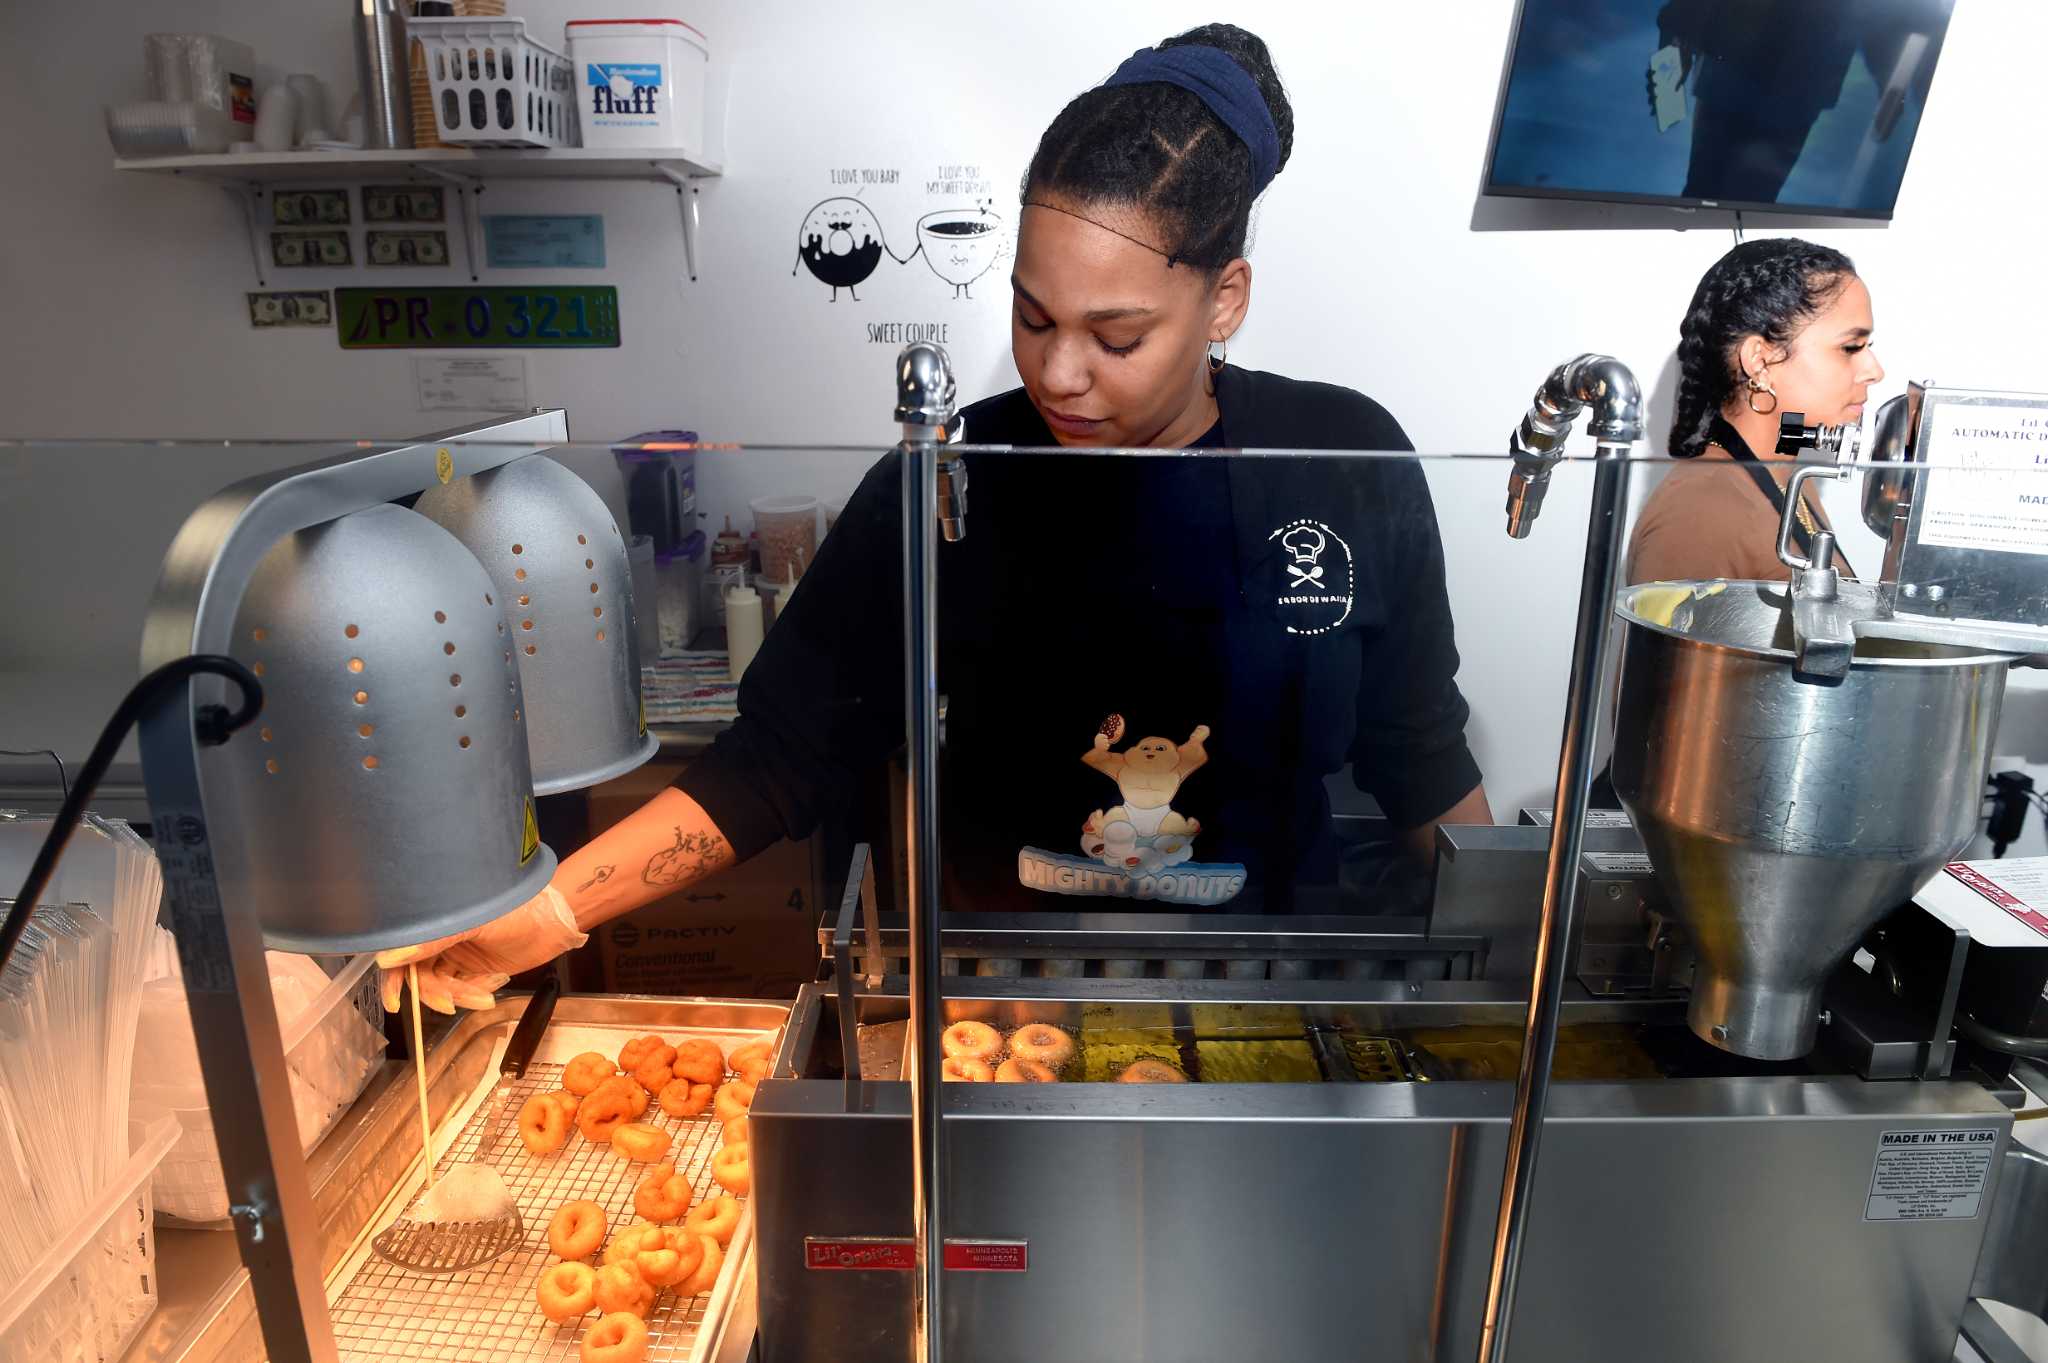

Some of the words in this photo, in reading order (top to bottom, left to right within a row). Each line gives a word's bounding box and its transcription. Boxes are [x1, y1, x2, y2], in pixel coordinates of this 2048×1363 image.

[592, 86, 658, 114] fluff
[830, 169, 836, 184] I
[837, 169, 858, 184] LOVE
[862, 169, 879, 184] YOU
[880, 169, 900, 184] BABY
[944, 165, 962, 180] LOVE
[964, 165, 980, 180] YOU
[926, 181, 939, 195] MY
[940, 181, 964, 195] SWEET
[867, 322, 903, 343] SWEET
[905, 322, 949, 343] COUPLE
[1951, 427, 2035, 441] AUTOMATIC
[1022, 856, 1130, 894] MIGHTY
[786, 887, 804, 912] 4
[647, 926, 738, 940] PACTIV
[615, 947, 715, 970] Conventional
[1883, 1134, 1919, 1144] MADE
[1922, 1134, 1937, 1143] IN
[1941, 1133, 1966, 1142] THE
[1968, 1132, 1994, 1142] USA
